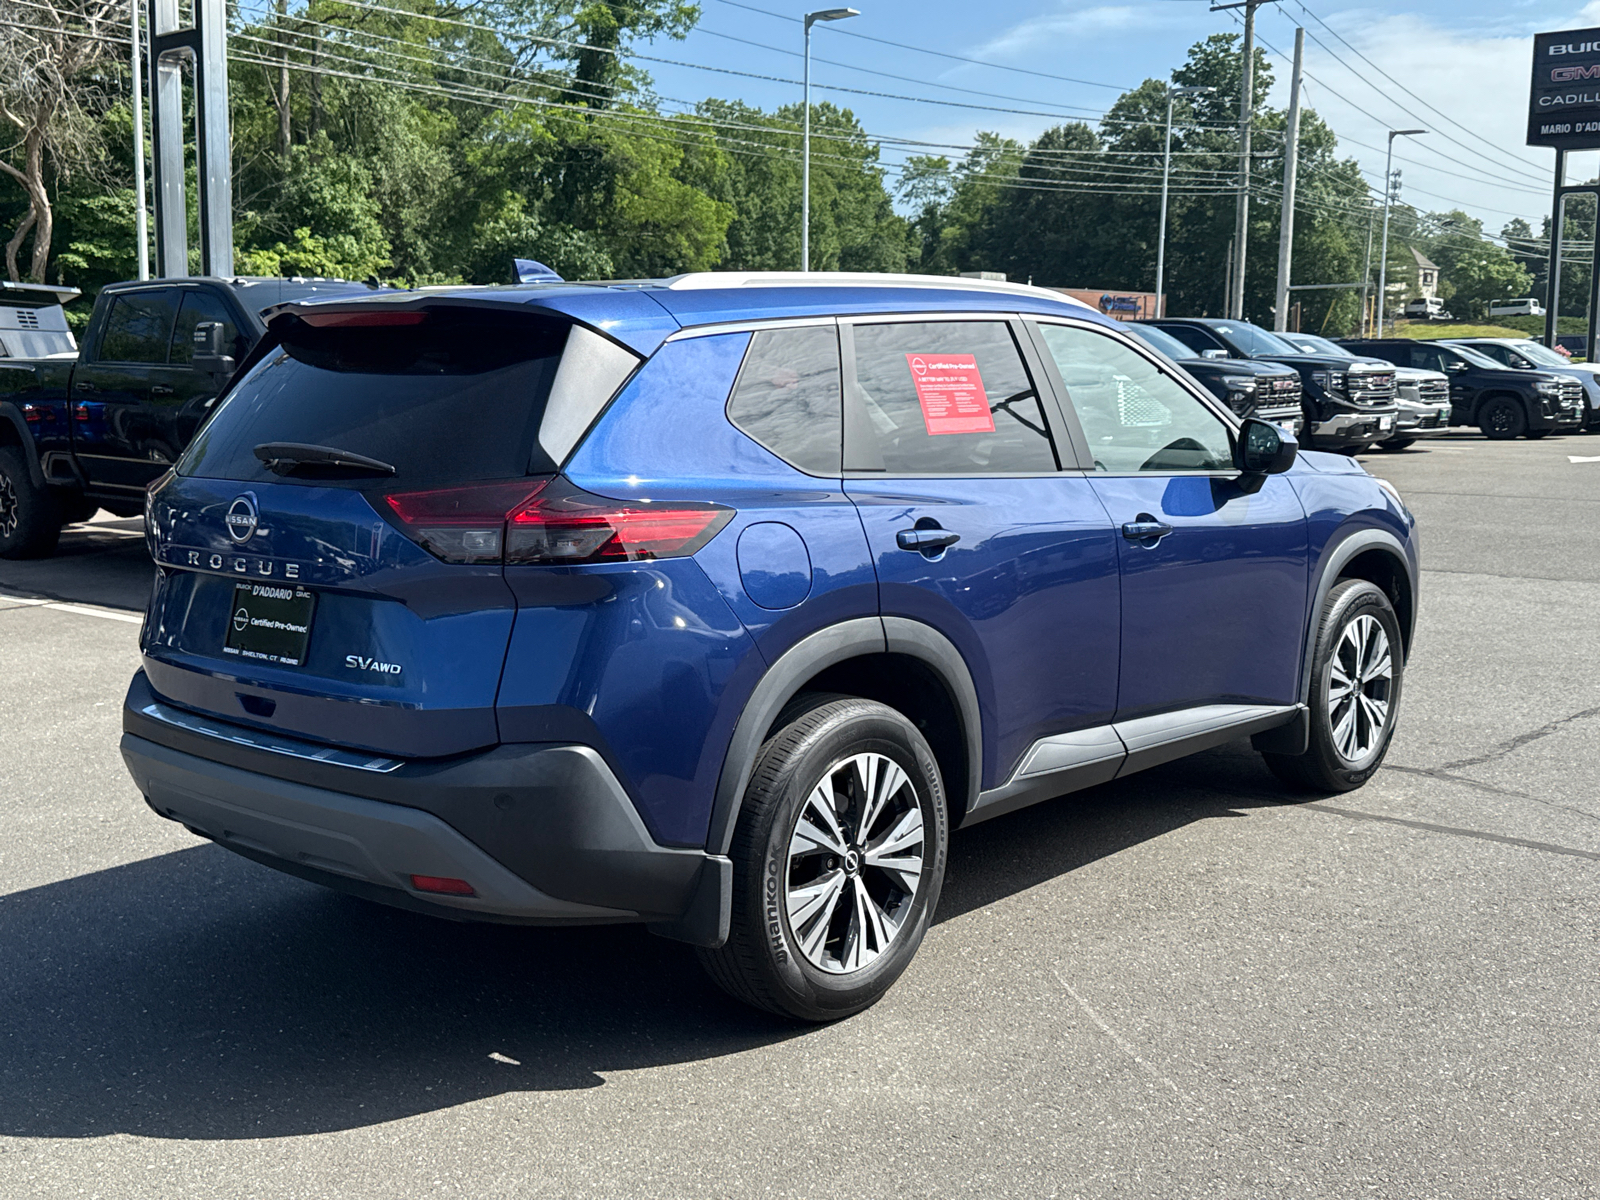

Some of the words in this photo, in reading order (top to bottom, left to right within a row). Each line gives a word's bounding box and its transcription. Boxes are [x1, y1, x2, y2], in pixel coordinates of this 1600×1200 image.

[1541, 123, 1571, 134] MARIO
[1576, 121, 1600, 132] D'AD
[226, 515, 257, 526] NISSAN
[188, 550, 299, 578] ROGUE
[252, 585, 293, 600] D'ADDARIO
[295, 591, 311, 599] GMC
[250, 617, 275, 628] Certified
[274, 620, 308, 633] Pre-Owned
[269, 654, 278, 662] CT
[345, 654, 374, 670] SV
[370, 661, 402, 674] AWD
